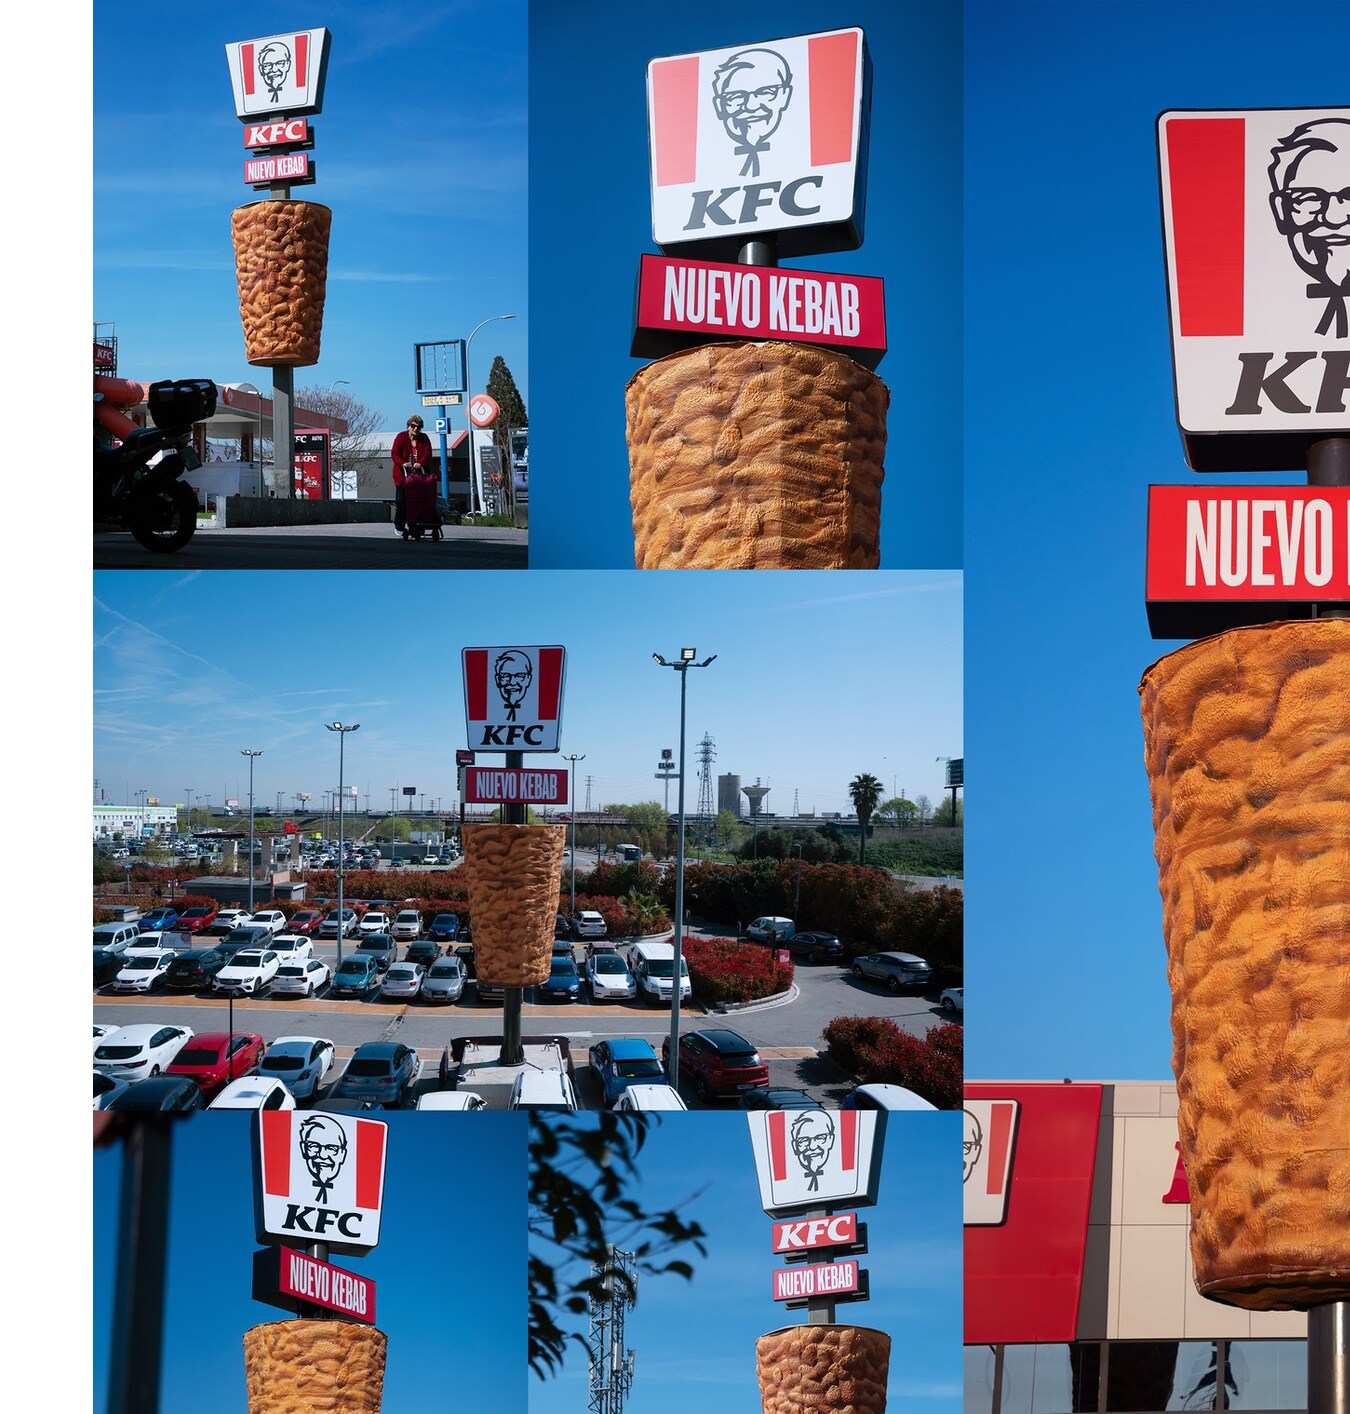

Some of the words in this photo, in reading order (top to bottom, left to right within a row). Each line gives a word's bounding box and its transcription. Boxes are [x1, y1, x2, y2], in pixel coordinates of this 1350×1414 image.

[247, 120, 303, 146] KFC
[248, 160, 275, 181] NUEVO
[277, 155, 304, 177] KEBAB
[683, 175, 824, 231] KFC
[663, 265, 761, 329] NUEVO
[769, 274, 861, 338] KEBAB
[97, 348, 112, 361] KFC
[294, 434, 307, 443] FC
[435, 419, 445, 433] P
[1185, 499, 1333, 588] NUEVO
[480, 724, 545, 746] KFC
[476, 771, 517, 800] NUEVO
[519, 772, 558, 800] KEBAB
[281, 1203, 363, 1239] KFC
[777, 1215, 852, 1250] KFC
[289, 1254, 330, 1302] NUEVO
[331, 1269, 367, 1315] KEBAB
[778, 1268, 815, 1297] NUEVO
[816, 1262, 854, 1292] KEBAB
